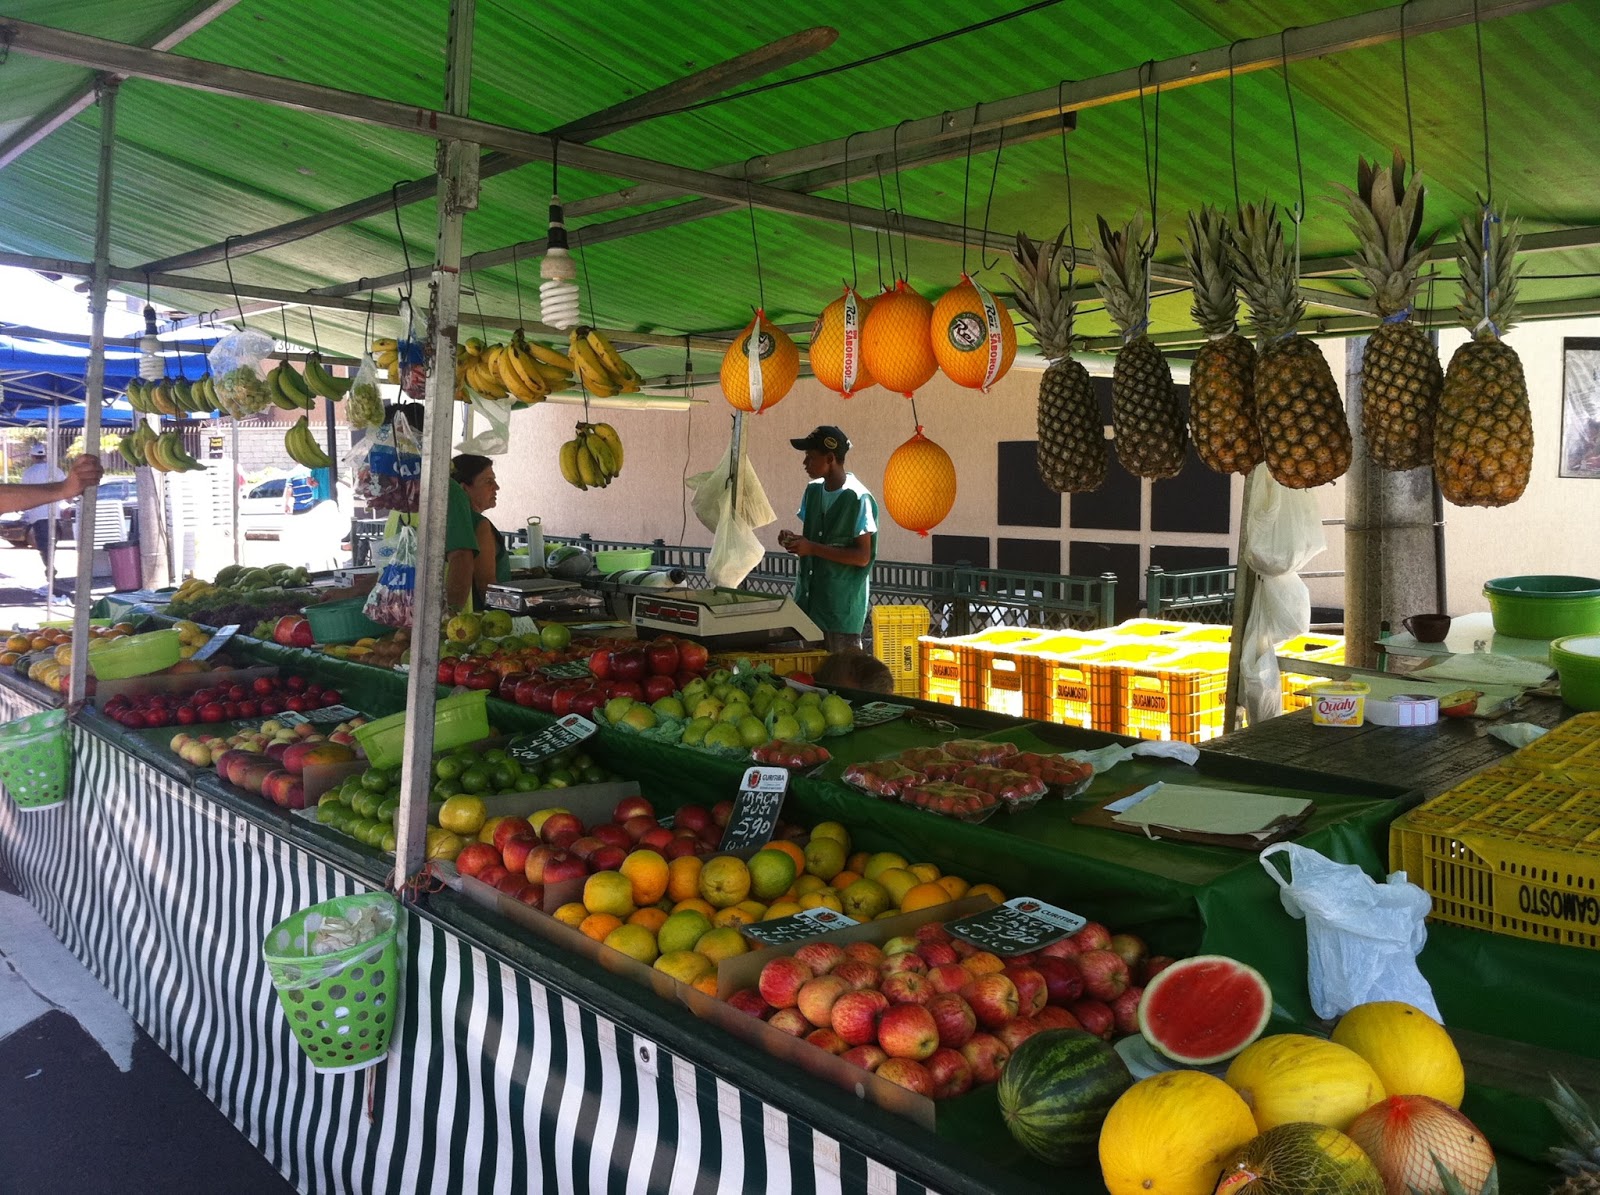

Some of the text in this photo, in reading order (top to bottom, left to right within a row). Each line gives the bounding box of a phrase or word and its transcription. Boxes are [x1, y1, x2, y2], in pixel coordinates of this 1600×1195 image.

[846, 305, 856, 326] Rei
[985, 304, 996, 329] Rei
[952, 318, 977, 347] Rei
[933, 664, 959, 679] SUGAMOSTO
[1057, 684, 1088, 701] SUGAMOSTO
[1132, 693, 1166, 710] SUGAMOSTO
[1318, 698, 1356, 715] Qualy
[1040, 909, 1080, 926] CURITIBA
